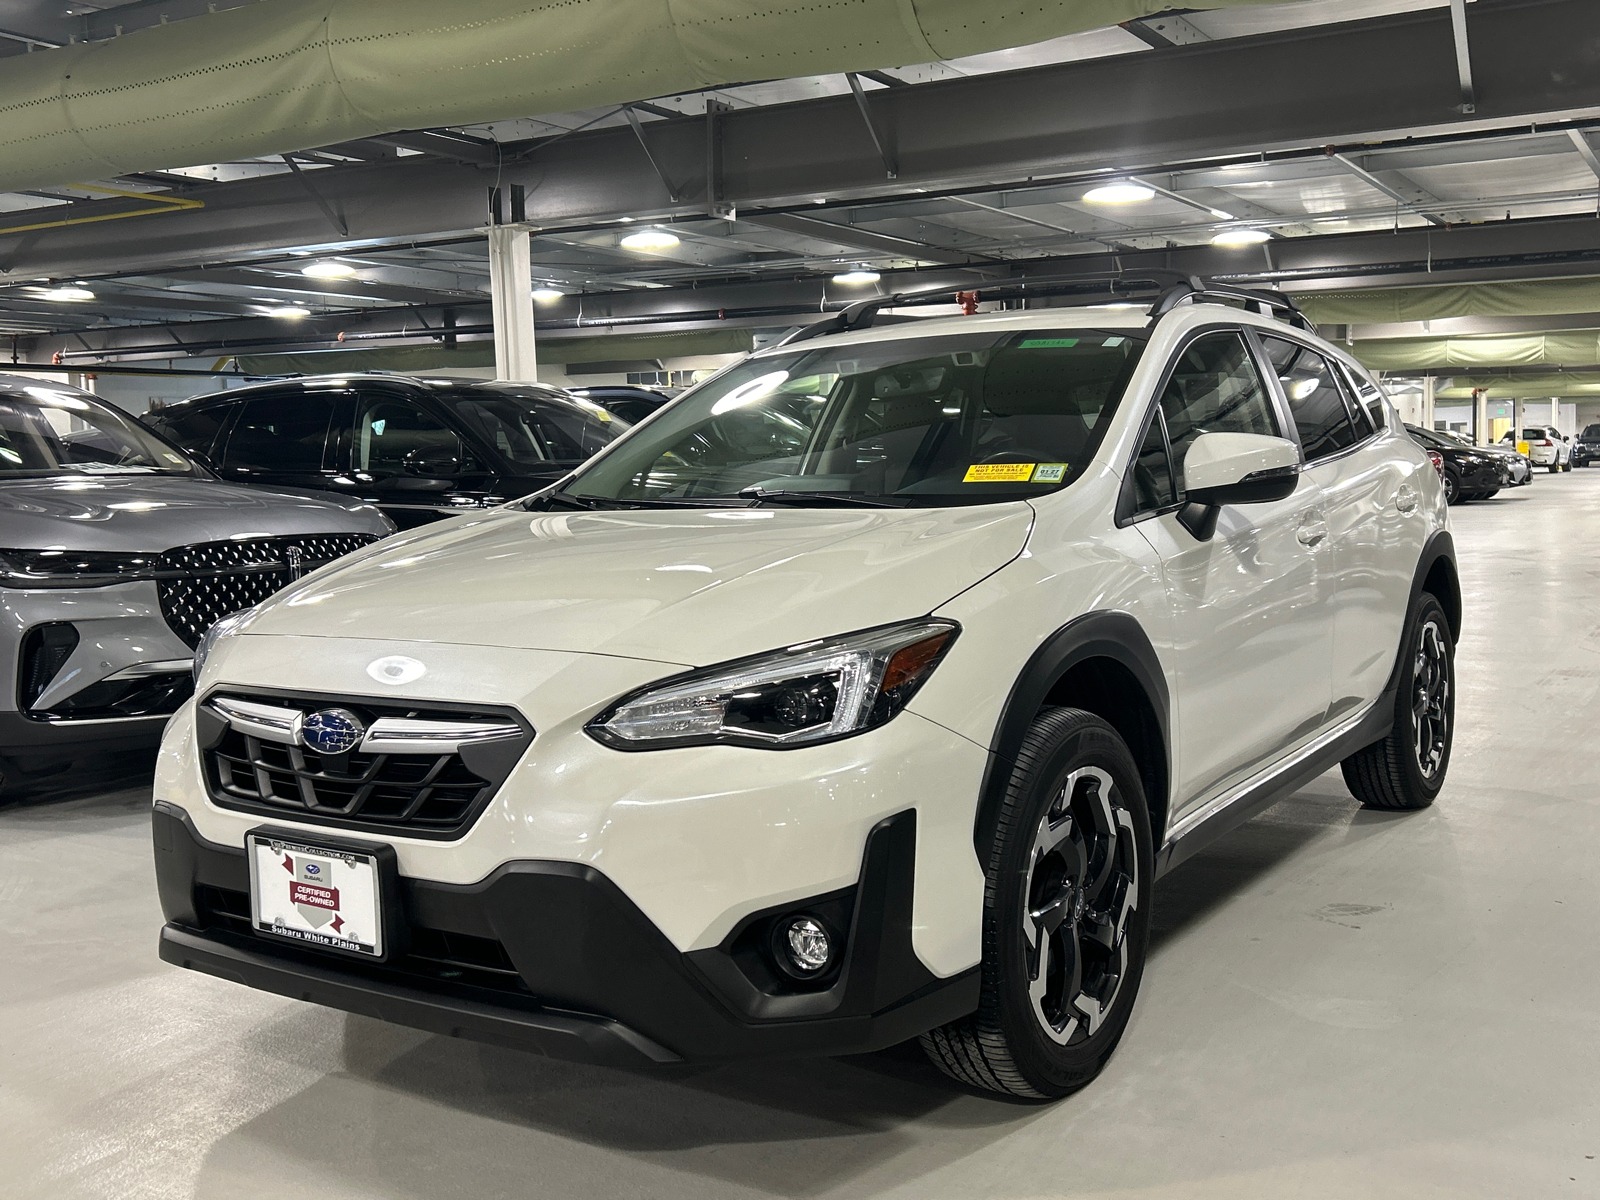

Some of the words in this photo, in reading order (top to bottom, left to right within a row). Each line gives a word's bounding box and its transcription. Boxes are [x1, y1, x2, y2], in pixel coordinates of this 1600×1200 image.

[304, 874, 323, 883] SUBARU
[297, 885, 331, 898] CERTIFIED
[294, 892, 335, 907] PRE-OWNED
[271, 924, 302, 938] Subaru
[303, 931, 330, 944] White
[331, 937, 361, 951] Plains
